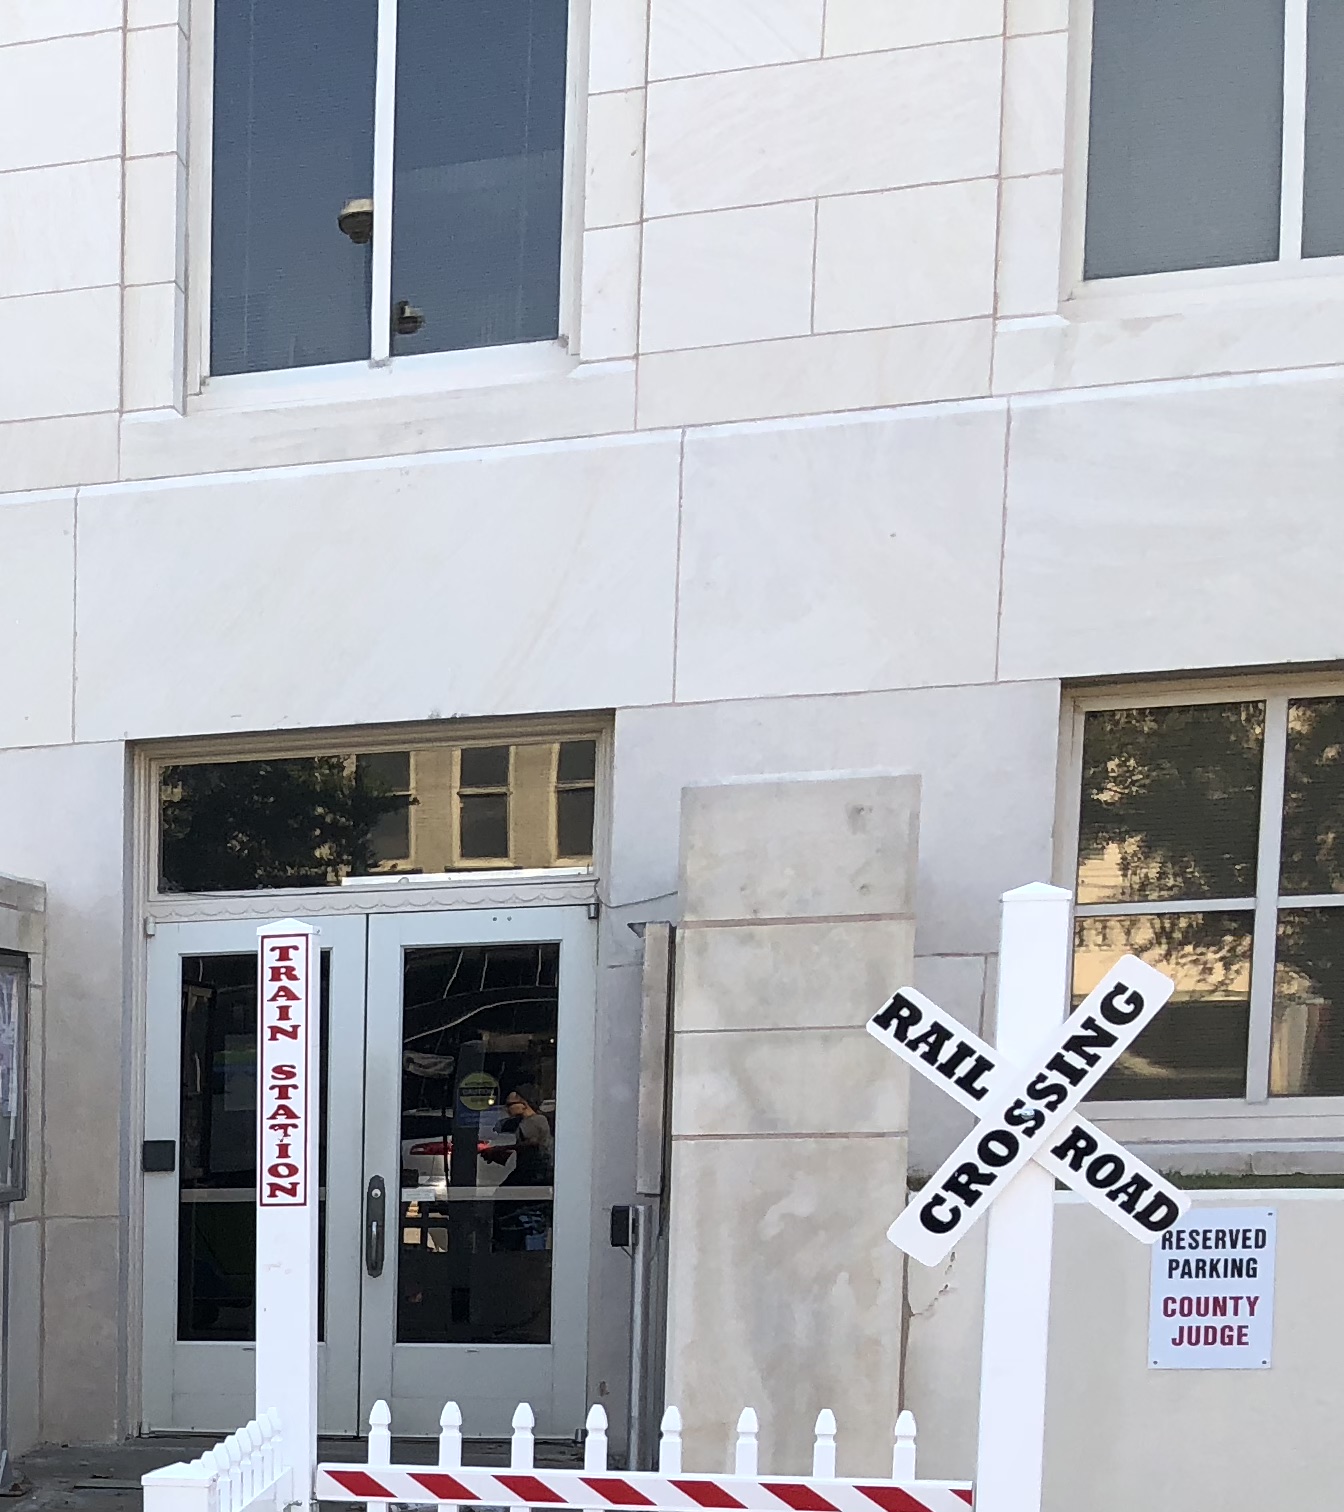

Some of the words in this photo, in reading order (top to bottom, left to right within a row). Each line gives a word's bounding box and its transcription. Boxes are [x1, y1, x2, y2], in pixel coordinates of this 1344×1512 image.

[267, 945, 302, 1042] TRAIN
[266, 1064, 302, 1199] STATION
[872, 992, 996, 1101] RAIL
[1050, 1124, 1180, 1232] ROAD
[919, 981, 1145, 1234] CROSSING
[1162, 1228, 1267, 1250] RESERVED
[1168, 1257, 1258, 1279] PARKING
[1163, 1296, 1260, 1318] COUNTY
[1171, 1325, 1250, 1347] JUDGE
